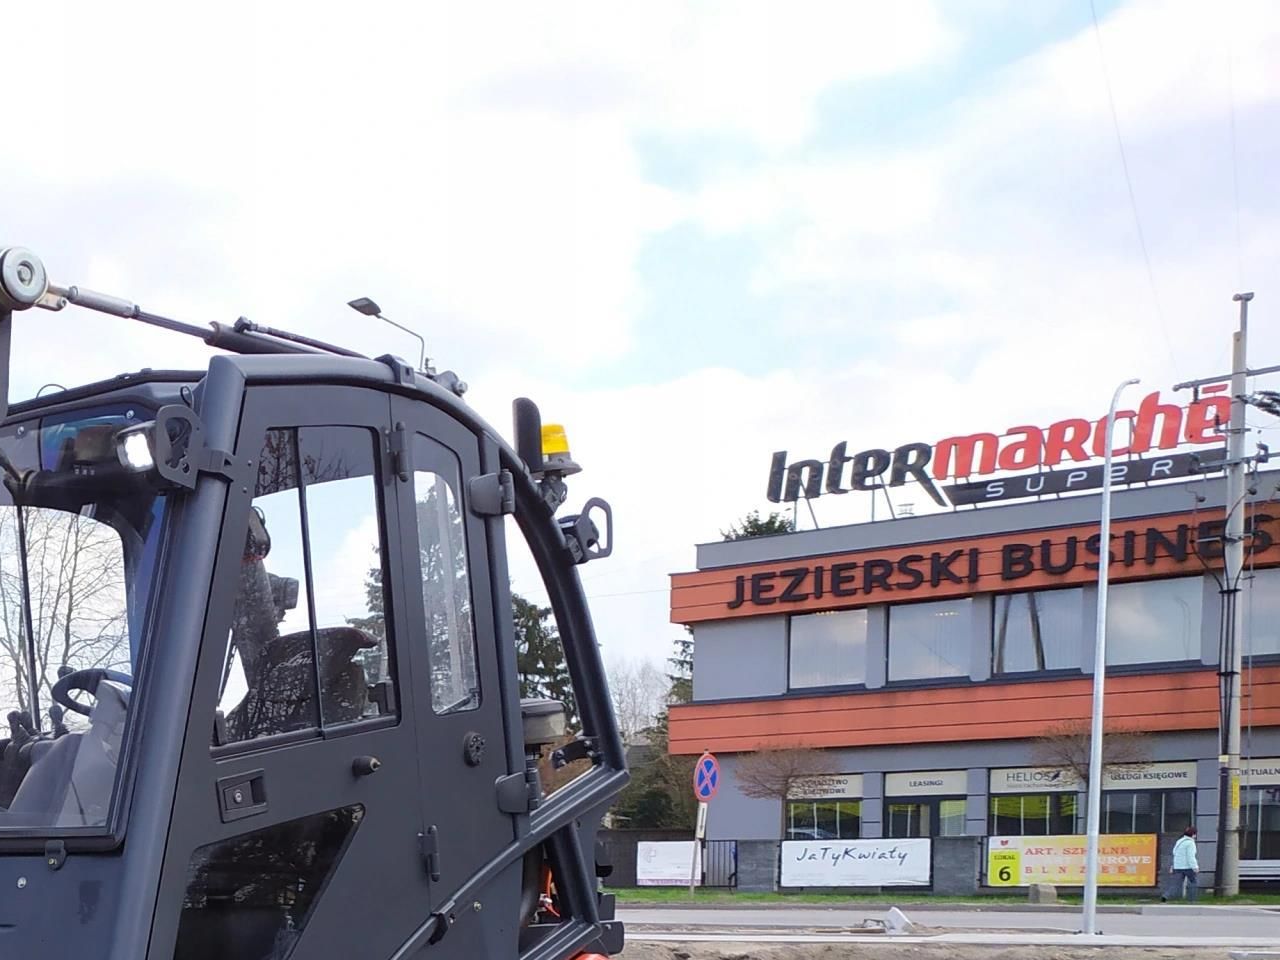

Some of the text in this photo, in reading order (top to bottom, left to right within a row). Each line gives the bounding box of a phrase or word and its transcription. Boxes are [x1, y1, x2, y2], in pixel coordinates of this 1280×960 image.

[727, 547, 980, 611] JEZIERSKI
[1006, 771, 1051, 782] HELIOS
[796, 846, 909, 867] JaTyKwiaty
[1024, 848, 1058, 856] ART.
[998, 865, 1012, 882] 6
